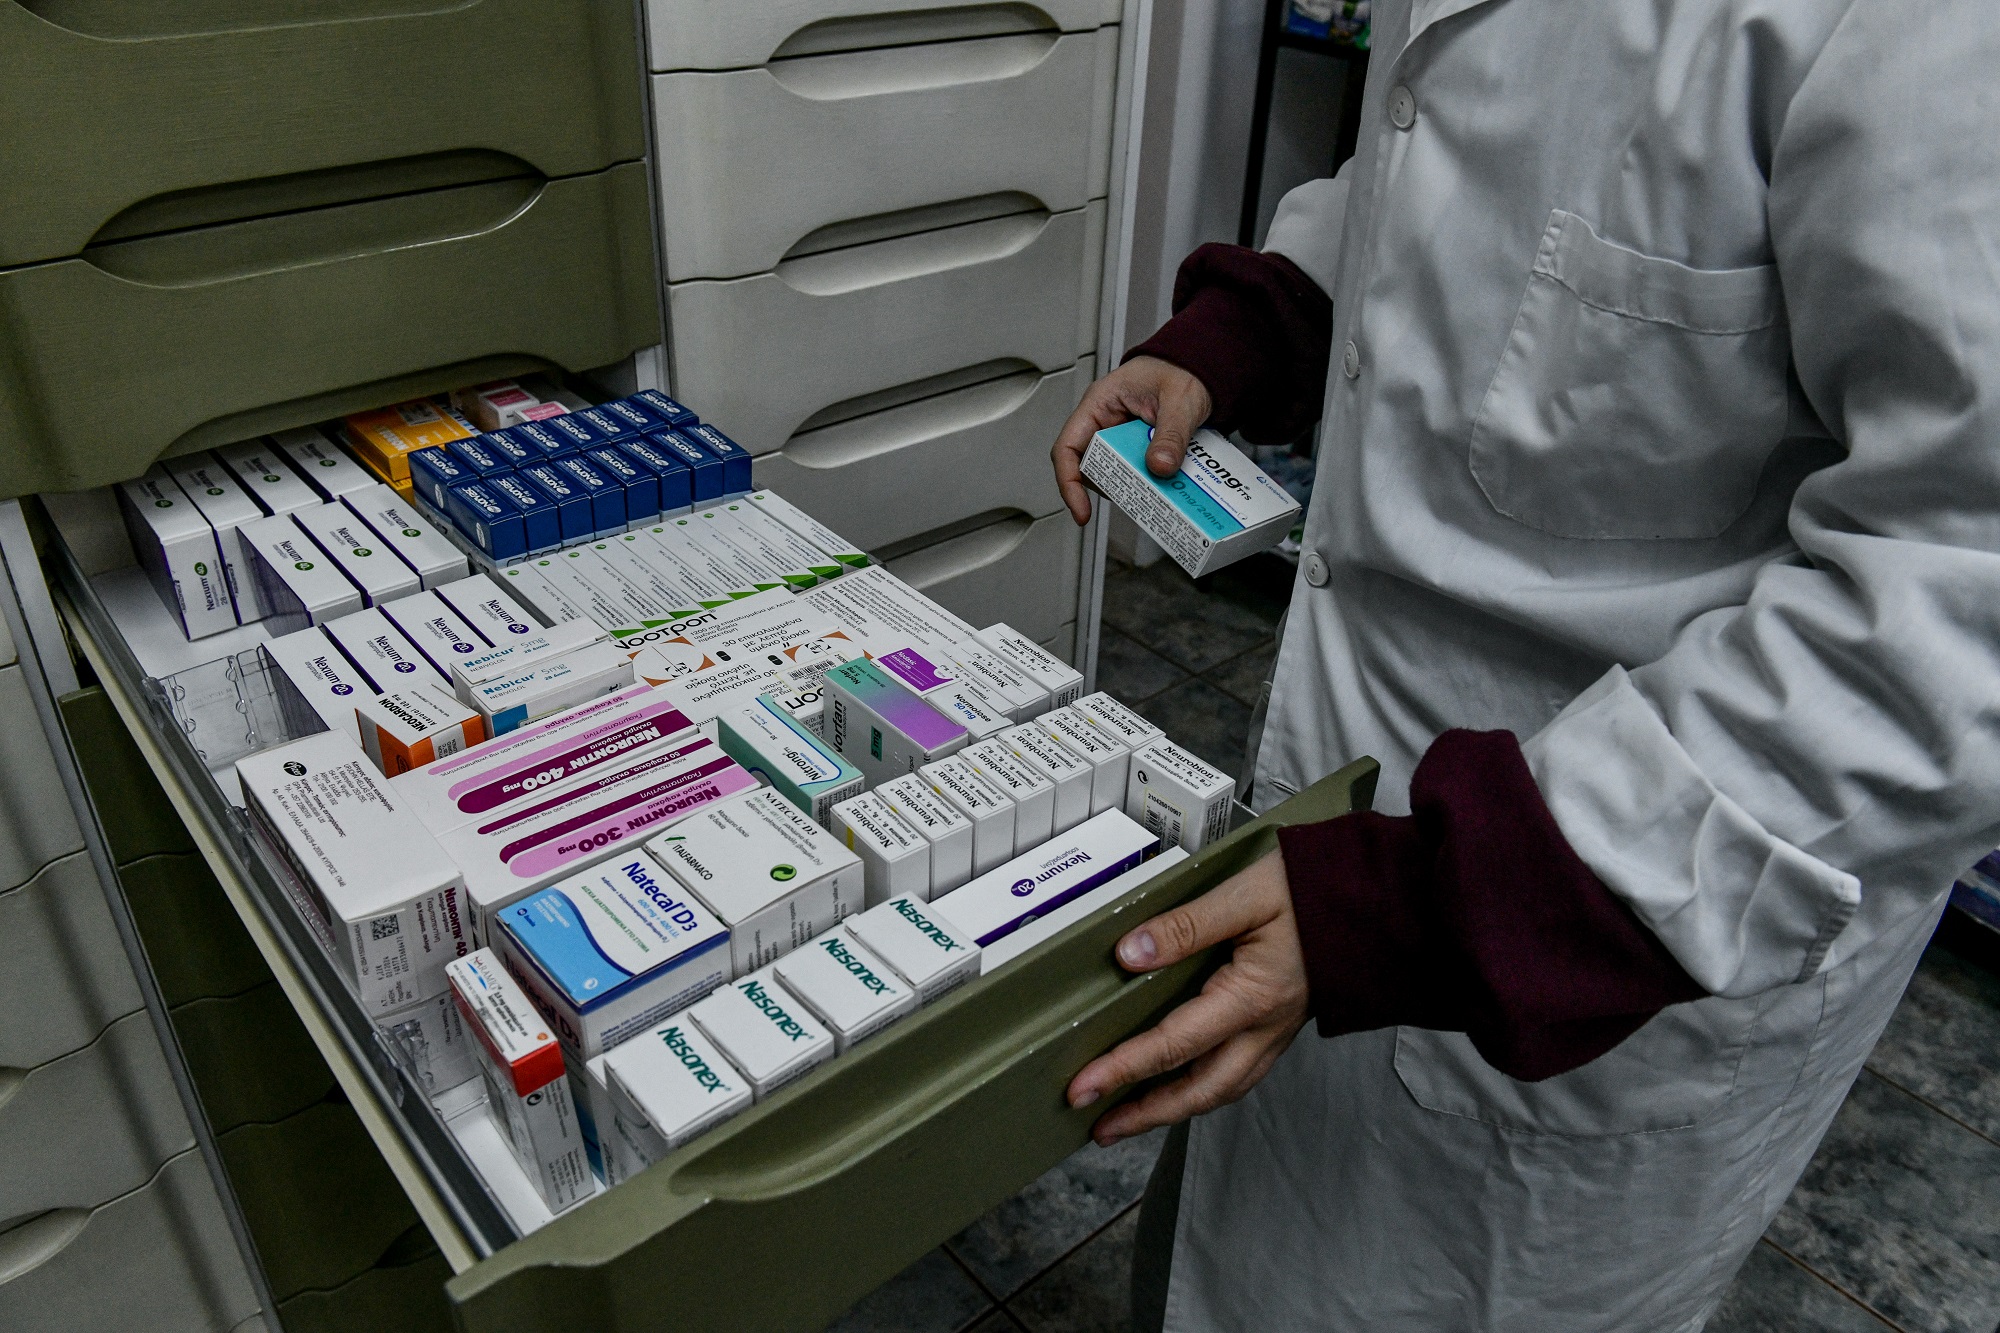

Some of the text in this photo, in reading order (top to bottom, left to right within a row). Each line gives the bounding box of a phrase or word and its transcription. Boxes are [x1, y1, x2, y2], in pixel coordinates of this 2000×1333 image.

[1188, 437, 1240, 488] itrong
[432, 618, 460, 642] Nexium
[486, 599, 514, 626] Nexium
[375, 635, 403, 662] Nexium
[464, 647, 513, 668] Nebicur
[313, 656, 341, 684] Nexium
[483, 673, 534, 695] Nebicur
[379, 698, 427, 732] NEOCARDON
[954, 702, 976, 719] 50 mg
[1090, 703, 1136, 737] Neurobion
[571, 727, 660, 770] NEURONTIN
[1017, 735, 1061, 771] Neurobion
[1054, 719, 1099, 754] Neurobion
[522, 766, 564, 791] 400
[790, 752, 822, 780] Nitrong
[978, 752, 1023, 790] Neurobion
[1164, 746, 1215, 780] Neurobion
[502, 782, 520, 794] mg
[938, 771, 981, 809] Neurobion
[558, 786, 721, 856] NEURONTIN 300 mg
[762, 792, 803, 826] NATECAL
[802, 822, 817, 836] D3
[895, 789, 937, 828] Neurobion
[851, 808, 894, 848] Neurobion
[672, 844, 713, 881] ITALFARMACO
[1018, 852, 1092, 893] Nexium 20
[445, 886, 463, 941] NEURONTIN
[621, 862, 698, 932] Natecal D3
[889, 898, 961, 952] Nasonex
[820, 937, 892, 996] Nasonex
[738, 980, 810, 1042] Nasonex
[657, 1026, 724, 1093] Nasonex
